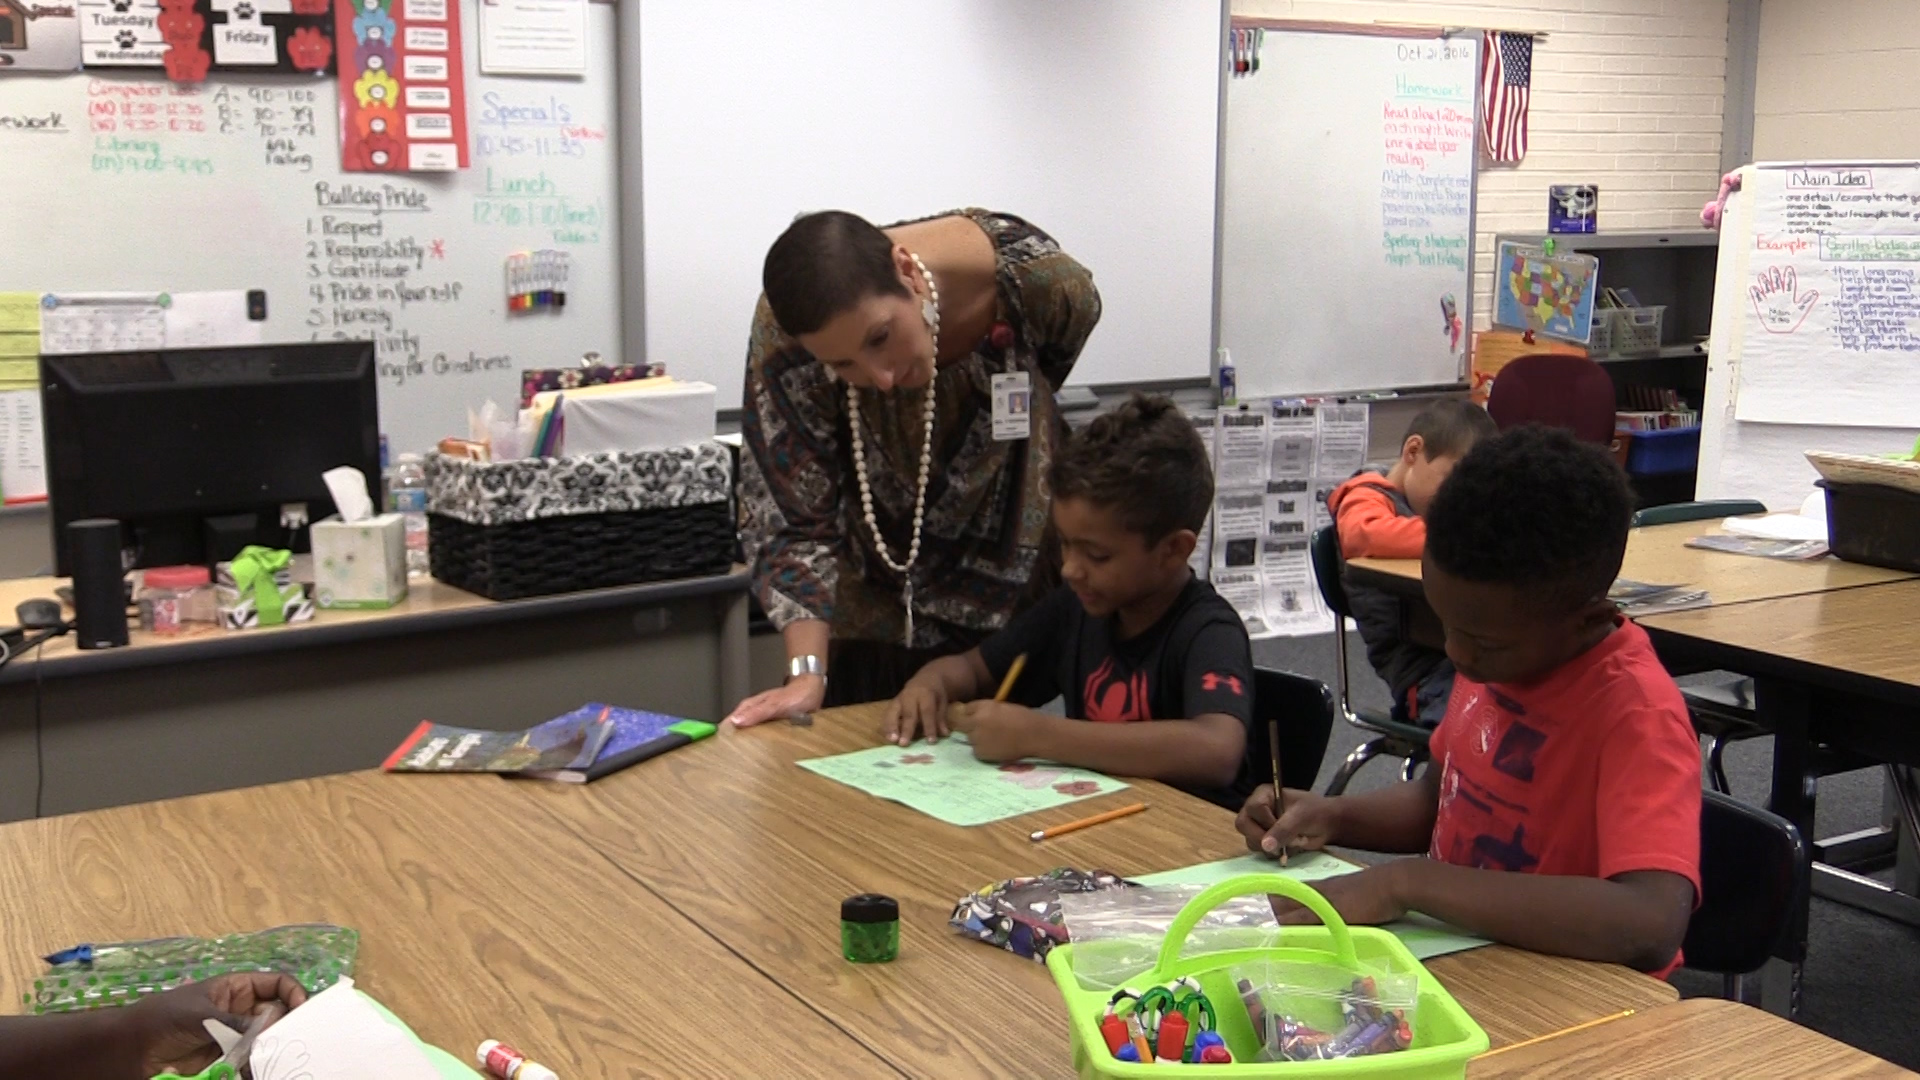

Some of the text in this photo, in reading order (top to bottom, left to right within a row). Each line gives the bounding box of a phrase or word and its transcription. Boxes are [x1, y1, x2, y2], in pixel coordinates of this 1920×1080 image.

[92, 13, 153, 28] Tuesday
[225, 30, 269, 45] Friday
[95, 49, 164, 60] Wednesda
[1396, 73, 1464, 96] Homework
[482, 91, 572, 126] Specials
[486, 166, 558, 194] Lunch
[1792, 170, 1867, 186] Main Idea
[315, 181, 427, 216] Bulldog Pride
[322, 215, 383, 242] Respect
[325, 236, 425, 270] Responsibility
[327, 261, 412, 279] Gratitude
[328, 281, 374, 302] Pride
[376, 281, 394, 301] in
[333, 305, 393, 331] Honesty
[433, 350, 513, 376] Greatness
